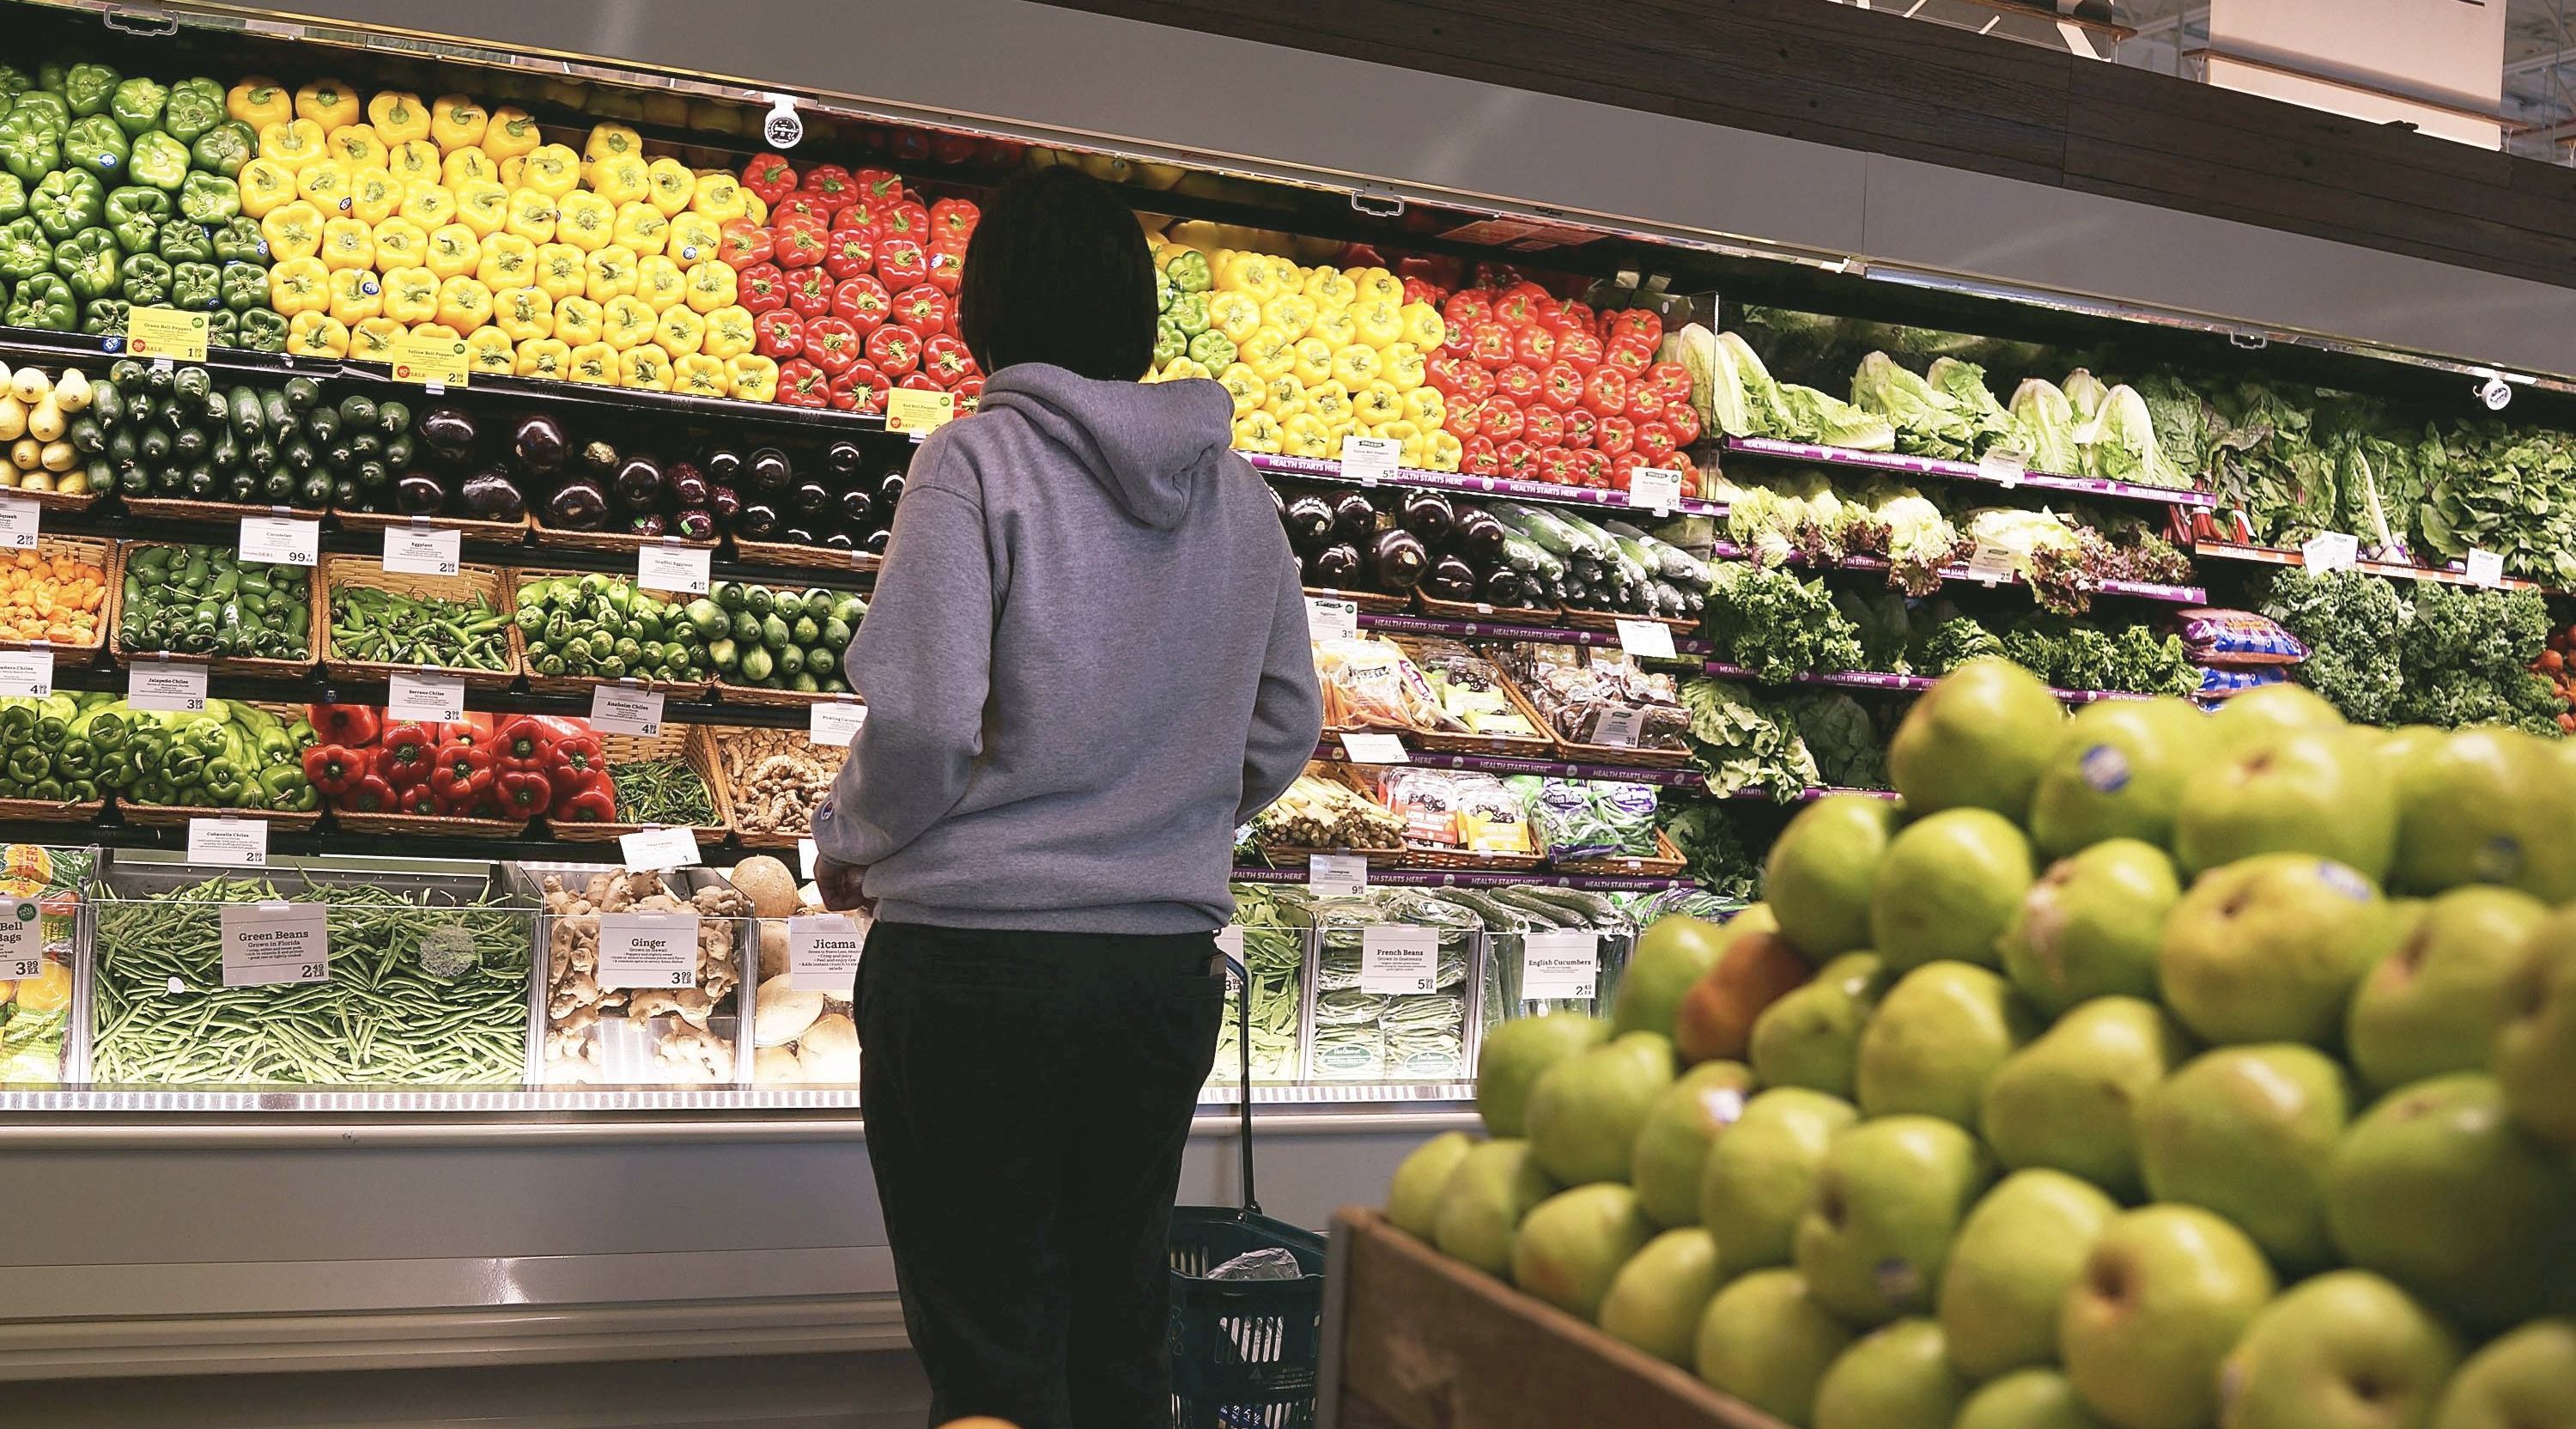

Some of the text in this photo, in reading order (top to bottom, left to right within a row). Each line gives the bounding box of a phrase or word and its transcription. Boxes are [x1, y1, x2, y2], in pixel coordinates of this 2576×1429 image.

[448, 373, 456, 383] 2
[1269, 458, 1324, 471] HEALTH STARTS
[1421, 474, 1443, 484] STARTS
[1444, 477, 1463, 486] HERE
[1510, 483, 1578, 498] HEALTH STARTS HERE
[17, 534, 25, 545] 2
[1728, 544, 1753, 555] HEATH
[2219, 545, 2258, 558] ORGANIC
[289, 551, 306, 562] 99
[440, 562, 447, 572] 2
[1855, 558, 1875, 568] STARTS
[2380, 563, 2418, 578] ORGANIC
[690, 581, 697, 590] 4
[1375, 618, 1446, 631] HEALTH STARTS HERE
[1342, 629, 1347, 638] 3
[1493, 627, 1561, 640] HEALTH STARTS HERE
[1720, 665, 1744, 674] HEALTH
[1823, 673, 1846, 682] HEALTH
[1868, 676, 1883, 684] HERE
[30, 684, 38, 694] 4
[187, 699, 194, 709] 3
[445, 710, 452, 720] 3
[642, 724, 649, 733] 4
[1416, 756, 1433, 764] HERE
[1479, 761, 1548, 772] HEALTH STARTS HERE
[1593, 769, 1618, 778] HEALTH
[1619, 771, 1642, 780] STARTS
[1546, 794, 1566, 804] Green
[246, 852, 254, 861] 2
[1230, 871, 1256, 879] HEALTH
[1257, 872, 1283, 880] STARTS
[1381, 874, 1405, 883] STARTS
[1352, 885, 1358, 895] 9
[0, 921, 23, 931] Bell
[239, 931, 309, 941] Green Beans
[631, 938, 666, 949] Ginger
[813, 939, 856, 949] Jicama
[15, 962, 27, 976] 3
[302, 965, 312, 978] 2
[671, 972, 680, 984] 3
[1418, 979, 1425, 989] 5
[1576, 986, 1583, 995] 2
